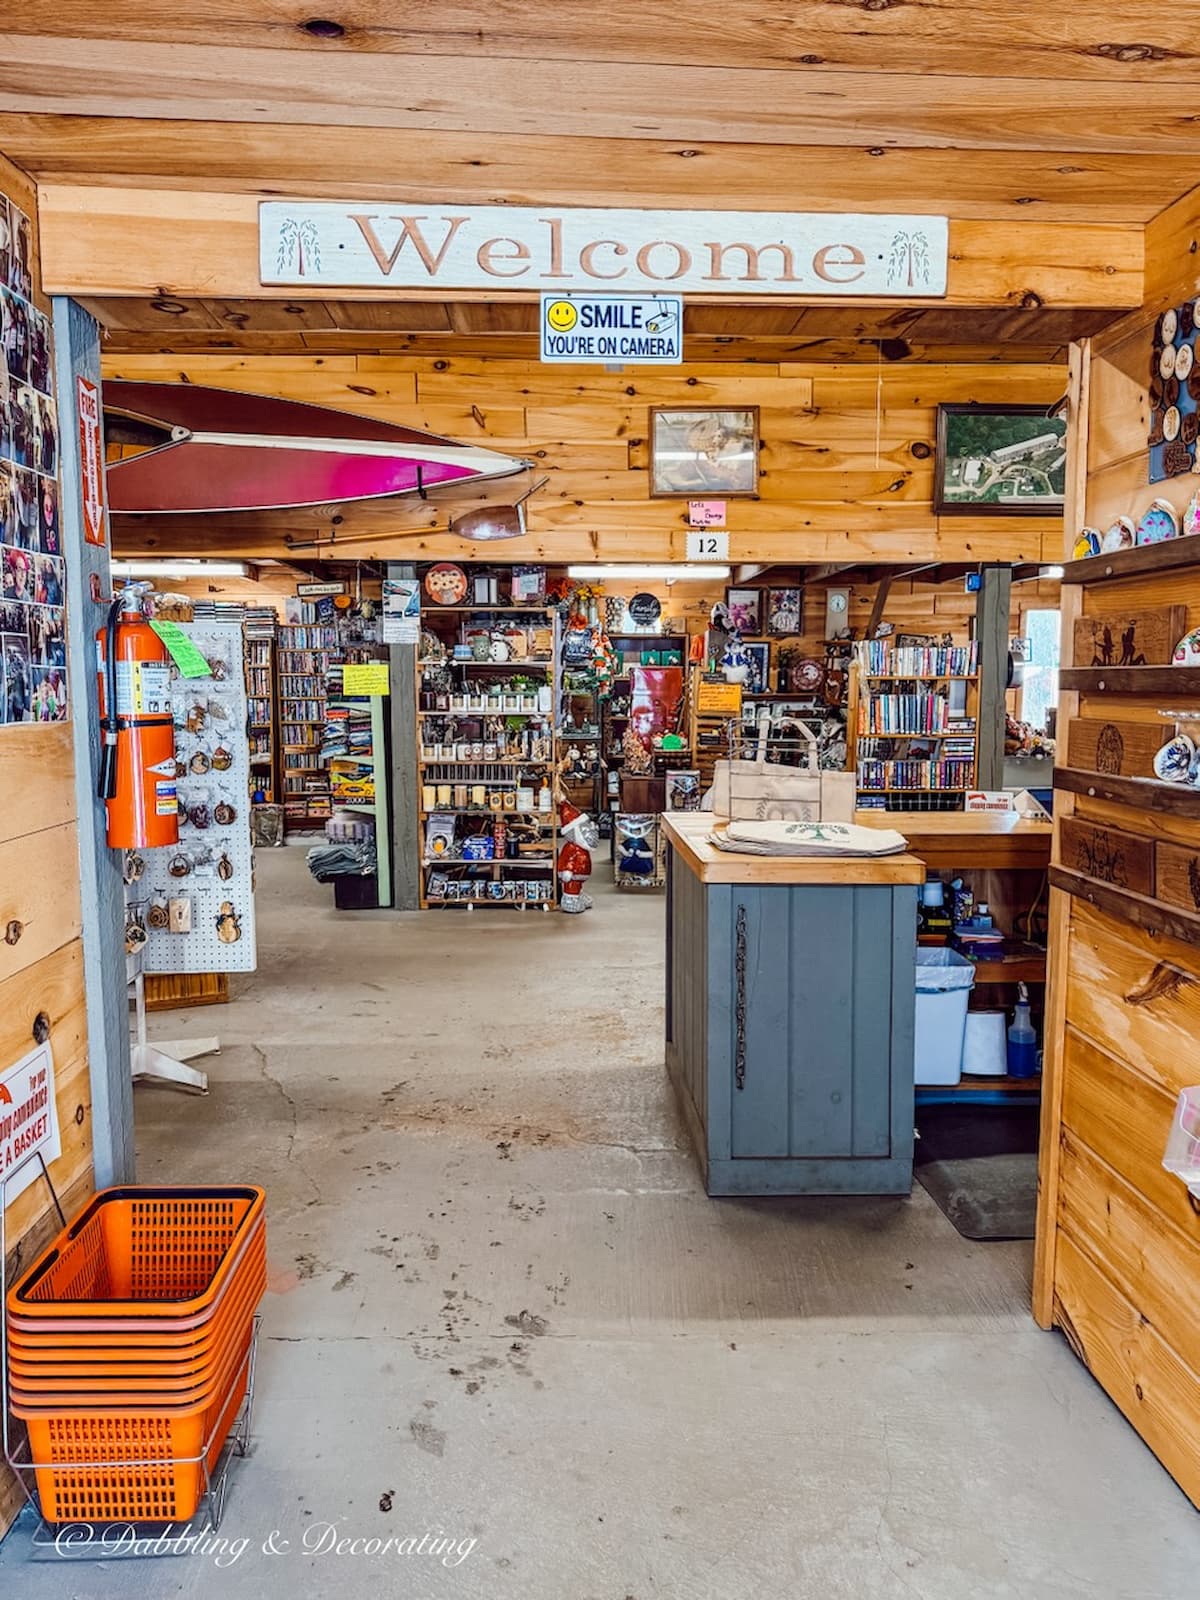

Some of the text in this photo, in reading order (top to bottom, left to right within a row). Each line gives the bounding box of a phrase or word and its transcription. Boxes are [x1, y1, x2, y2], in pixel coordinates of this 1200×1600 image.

[346, 214, 866, 284] Welcome
[580, 304, 643, 329] SMILE
[547, 335, 676, 356] YOU'RE ON CAMERA
[81, 392, 97, 420] FIRE
[698, 538, 718, 553] 12
[6, 1145, 12, 1168] A
[14, 1113, 48, 1159] BASKET
